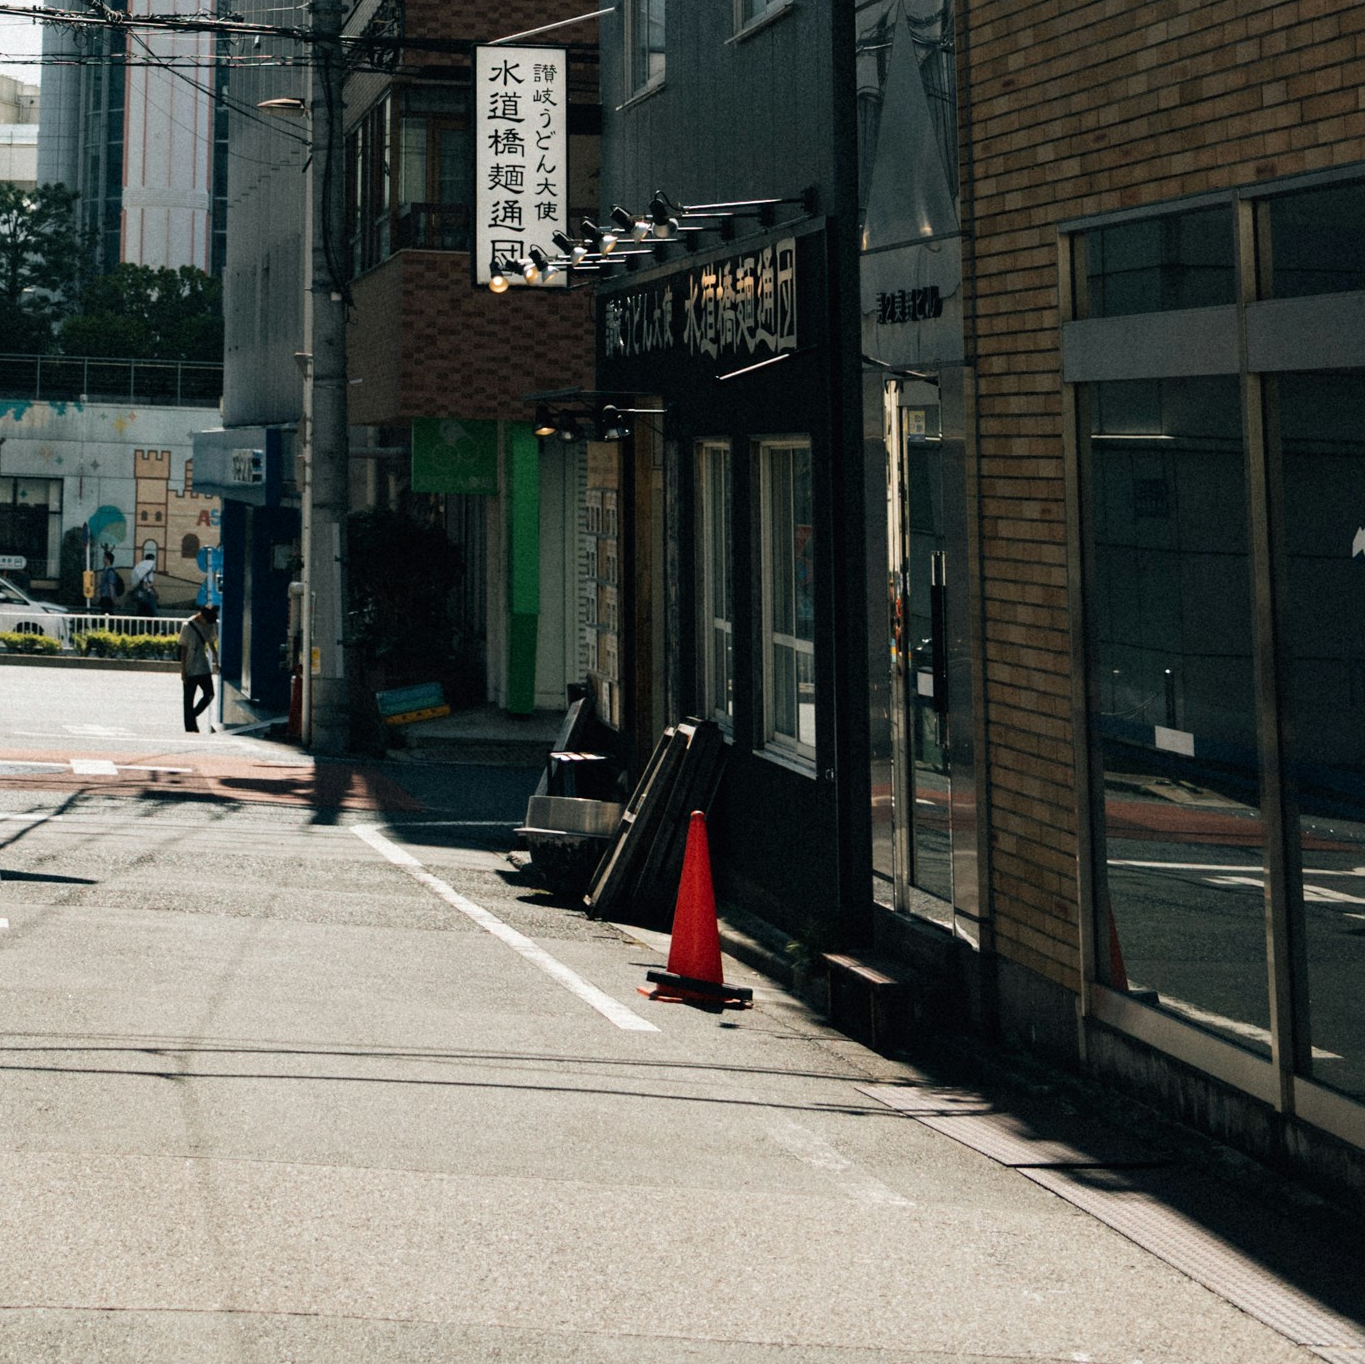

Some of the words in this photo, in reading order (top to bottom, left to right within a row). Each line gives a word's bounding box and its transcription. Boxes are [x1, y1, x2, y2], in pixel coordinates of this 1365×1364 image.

[487, 59, 527, 276] 水道橋麺通団
[532, 63, 559, 222] 讃岐うどん大使
